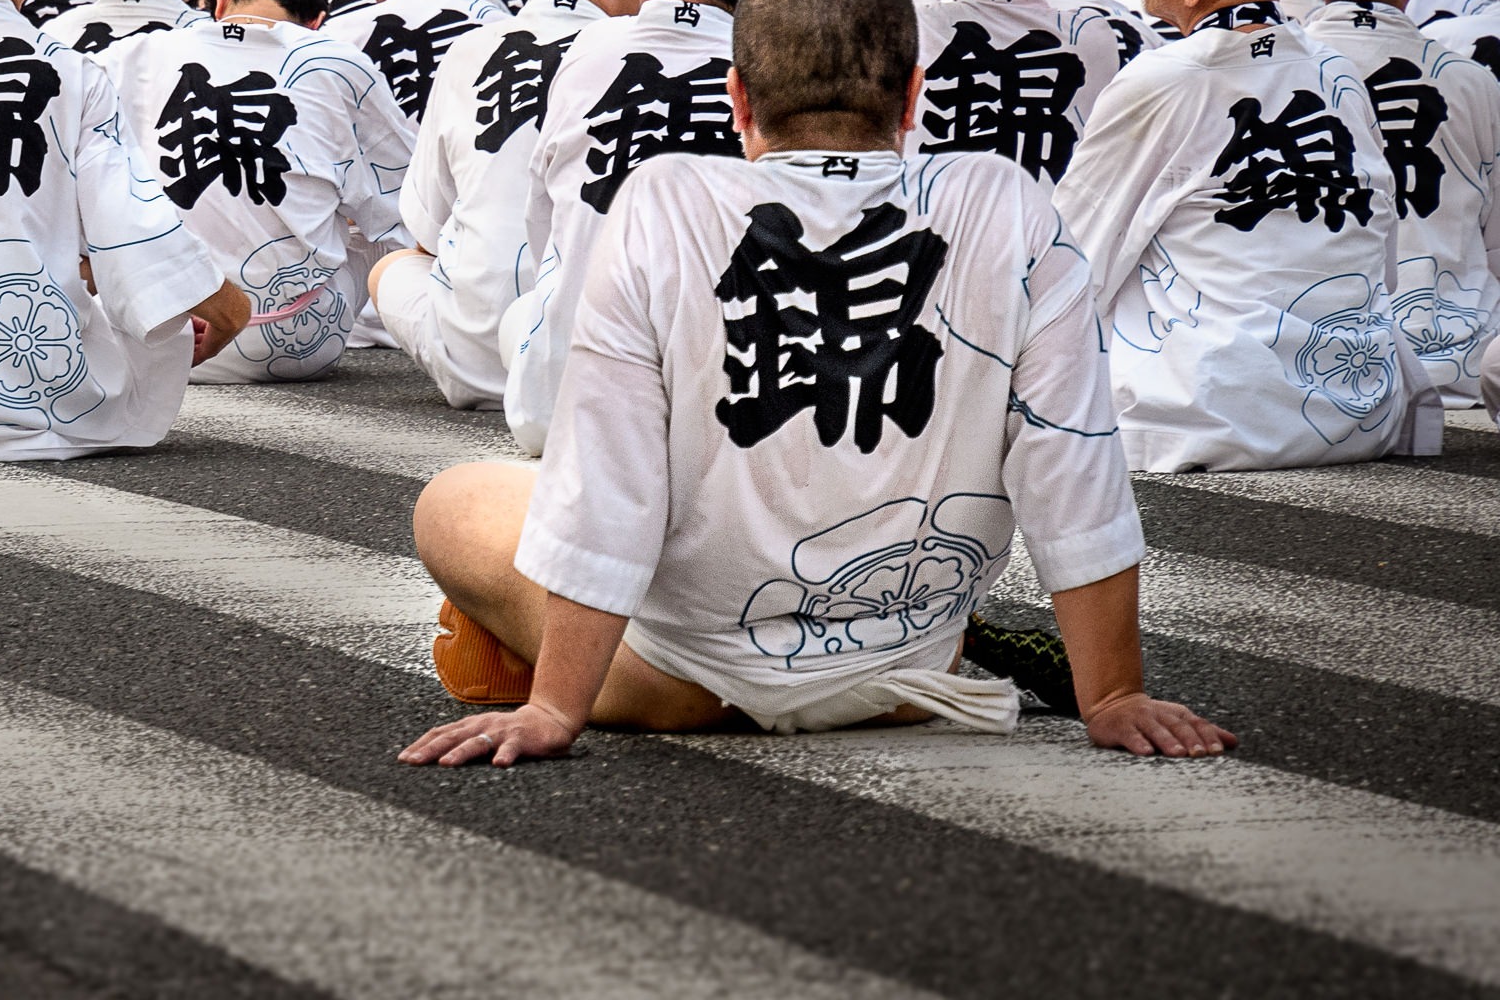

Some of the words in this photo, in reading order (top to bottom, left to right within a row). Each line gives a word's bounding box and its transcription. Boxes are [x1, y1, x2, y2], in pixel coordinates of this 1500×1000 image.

[222, 23, 246, 42] 西
[674, 1, 701, 28] 西
[1250, 33, 1276, 59] 西
[156, 63, 298, 210] 錦
[919, 21, 1087, 188] 錦
[1211, 90, 1374, 233] 錦
[714, 202, 949, 455] 錦
